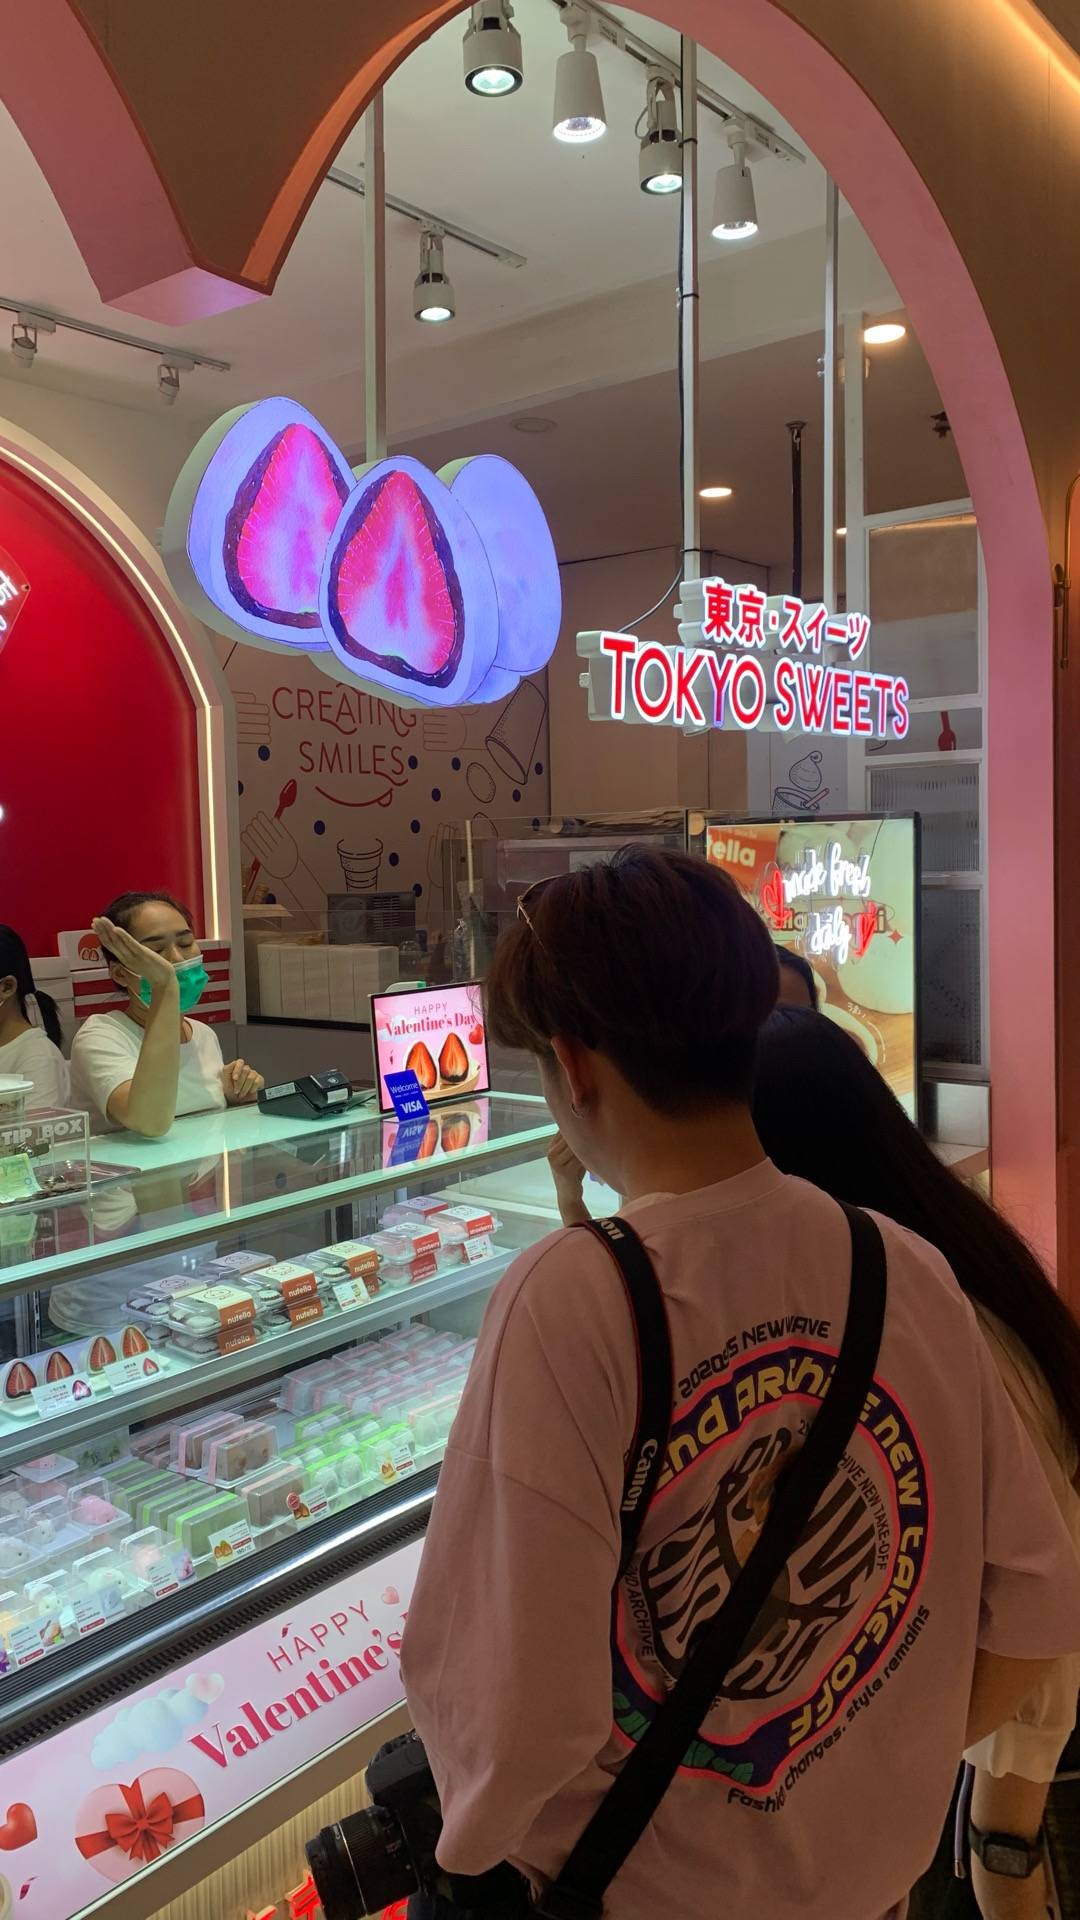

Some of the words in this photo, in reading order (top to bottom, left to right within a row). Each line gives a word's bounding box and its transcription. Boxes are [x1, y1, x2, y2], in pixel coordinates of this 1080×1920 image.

[703, 580, 870, 659] 東京・スイーツ
[602, 636, 766, 728] TOKYO
[773, 660, 909, 738] SWEETS
[272, 686, 417, 737] CREATING
[299, 741, 409, 786] SMILES
[385, 1014, 453, 1037] Valentine's
[414, 1002, 448, 1016] HAPPY
[390, 1081, 419, 1095] Welcome
[400, 1099, 424, 1114] VISA
[1, 1128, 33, 1146] TIP
[41, 1119, 83, 1139] BOX
[288, 1285, 312, 1298] nutella
[295, 1307, 318, 1321] nutella
[227, 1311, 252, 1325] nutella
[621, 1438, 659, 1512] Canon
[858, 1477, 882, 1507] NEW
[873, 1503, 890, 1570] TAKE-OFF
[266, 1600, 369, 1673] HAPPY
[627, 1588, 655, 1657] ARCHIVE
[846, 1677, 884, 1723] style
[883, 1605, 931, 1679] remains
[187, 1628, 402, 1769] Valentine's
